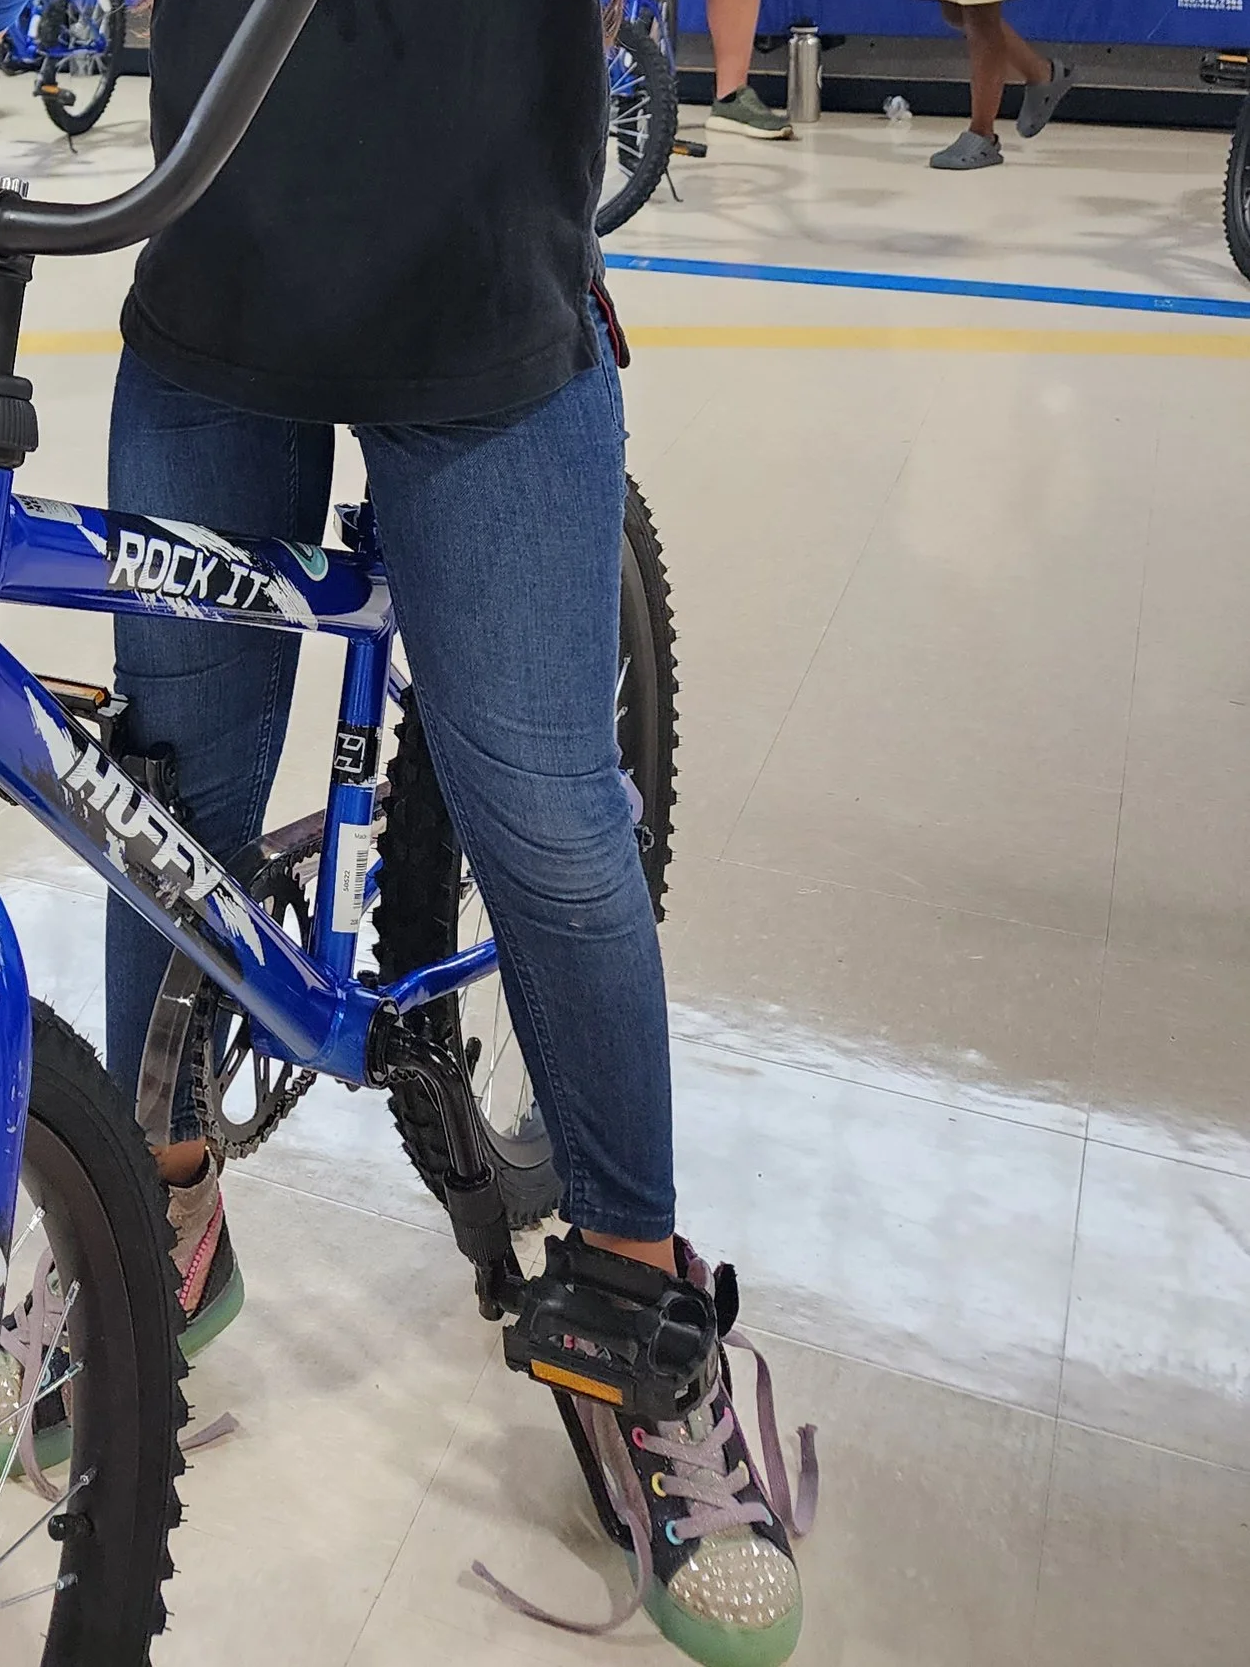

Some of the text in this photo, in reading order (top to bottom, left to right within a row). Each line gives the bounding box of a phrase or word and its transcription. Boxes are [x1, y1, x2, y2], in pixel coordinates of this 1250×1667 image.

[109, 530, 270, 609] ROCK IT
[65, 742, 222, 901] HUFFY
